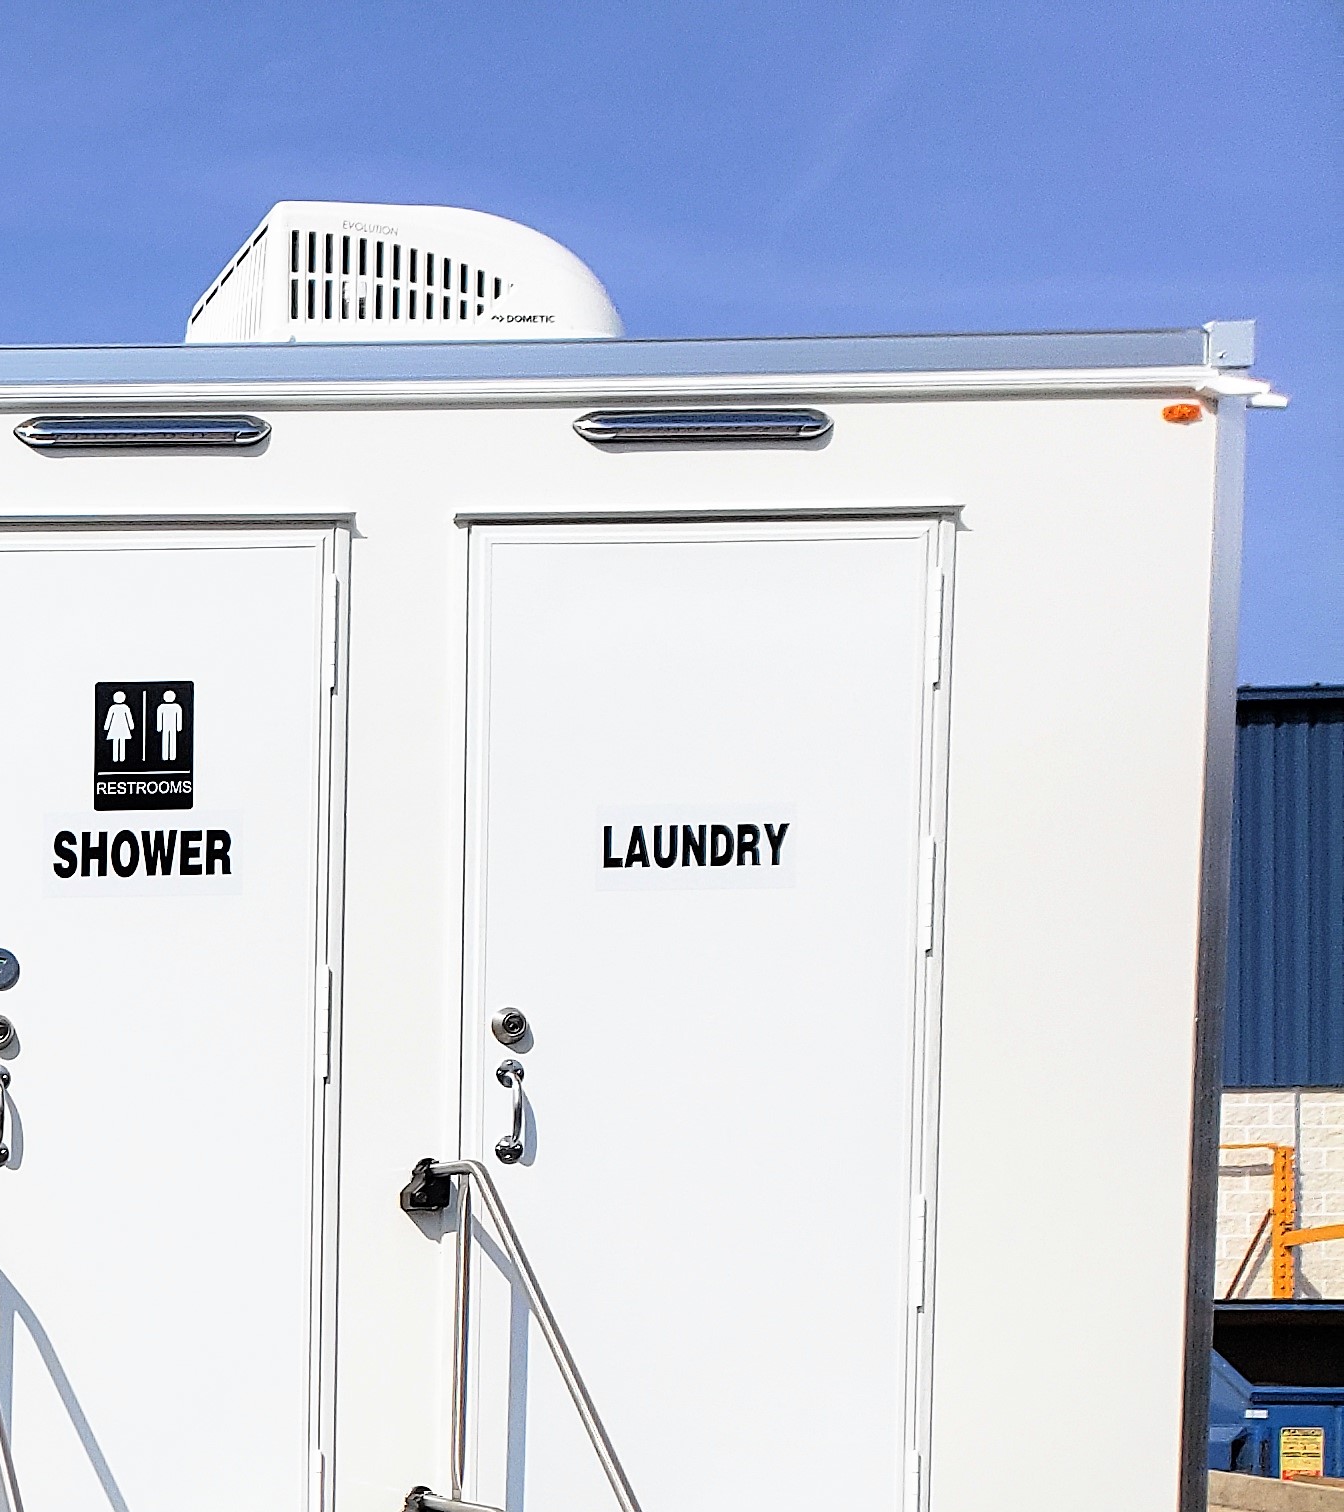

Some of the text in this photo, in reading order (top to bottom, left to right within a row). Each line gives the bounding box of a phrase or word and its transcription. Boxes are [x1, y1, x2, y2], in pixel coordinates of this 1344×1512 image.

[343, 219, 398, 237] EVOLUTION
[506, 314, 555, 323] DOMETIC
[96, 780, 192, 795] RESTROOMS
[53, 829, 232, 879] SHOWER
[603, 822, 790, 869] LAUNDRY
